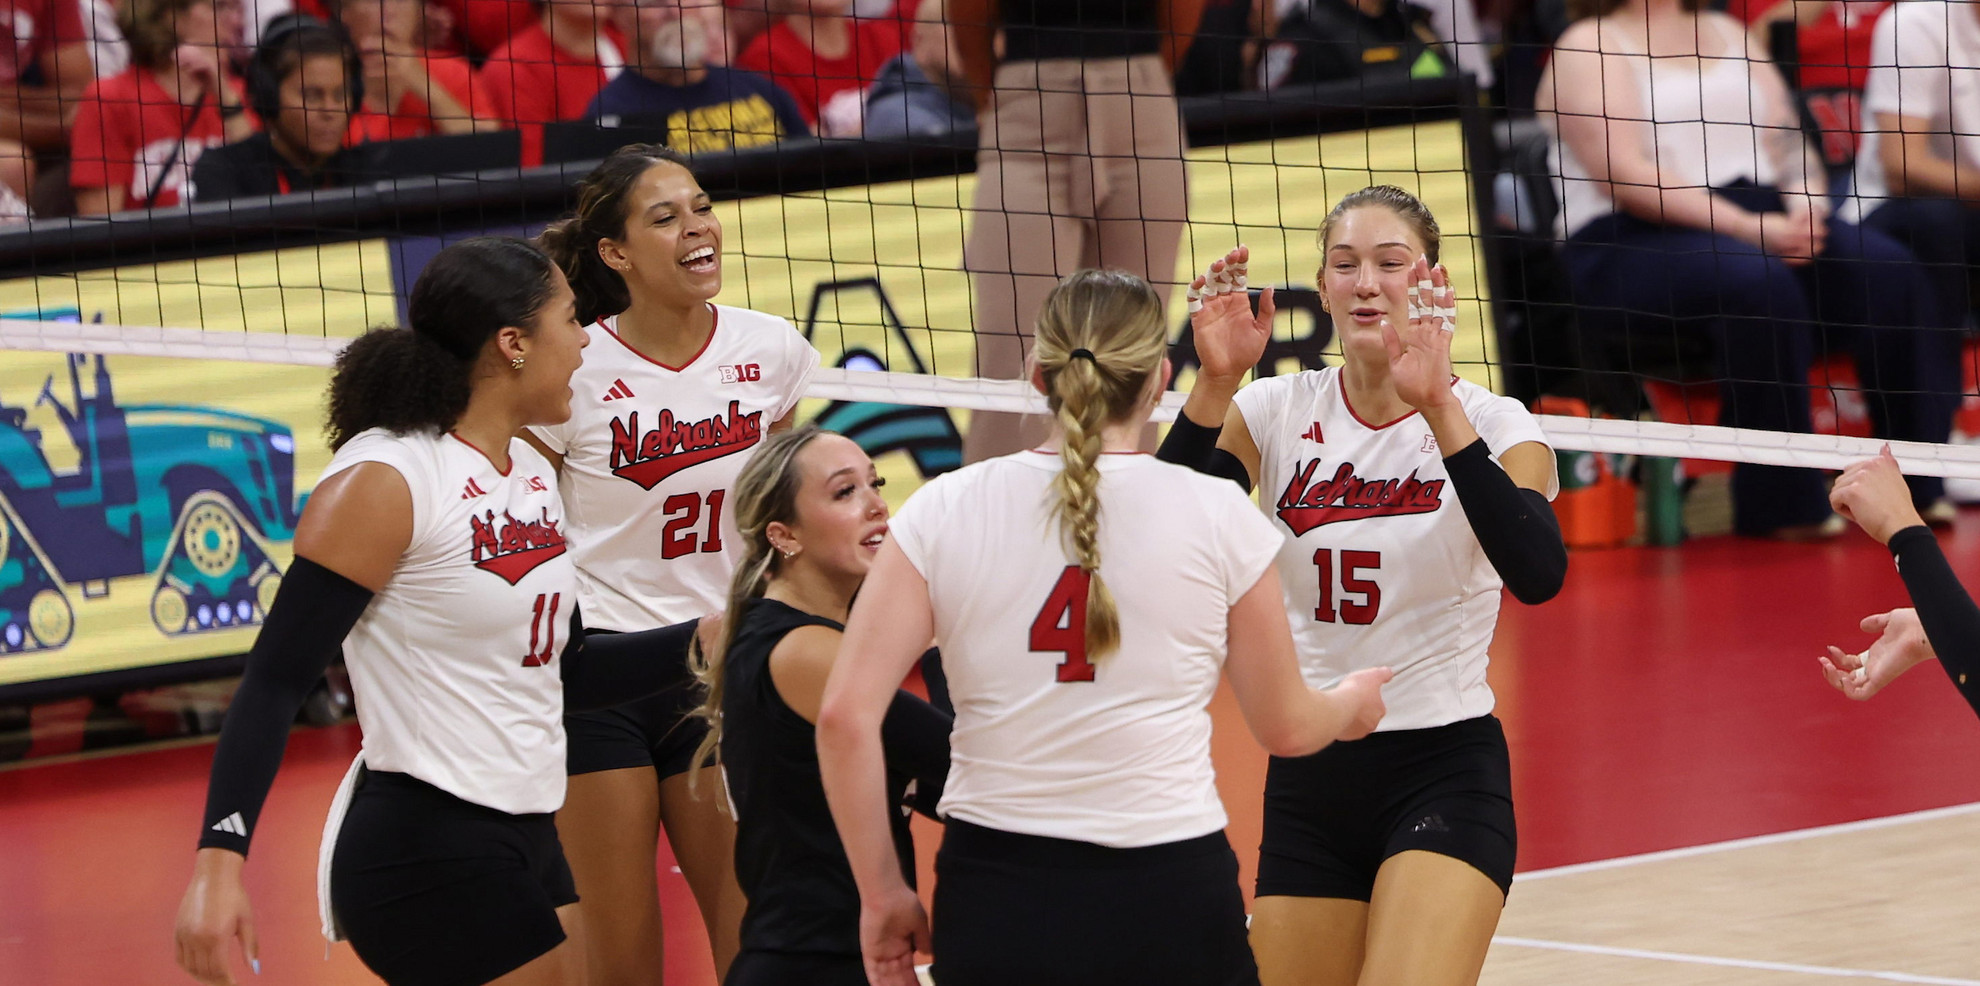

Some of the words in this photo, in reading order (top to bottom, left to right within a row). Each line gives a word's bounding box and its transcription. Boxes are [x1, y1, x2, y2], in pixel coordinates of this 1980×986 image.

[609, 400, 763, 472] Nebraska
[1276, 457, 1446, 512] Nebraska
[661, 489, 725, 559] 21
[1312, 548, 1381, 625] 15
[521, 592, 560, 667] 11
[1028, 565, 1095, 683] 4
